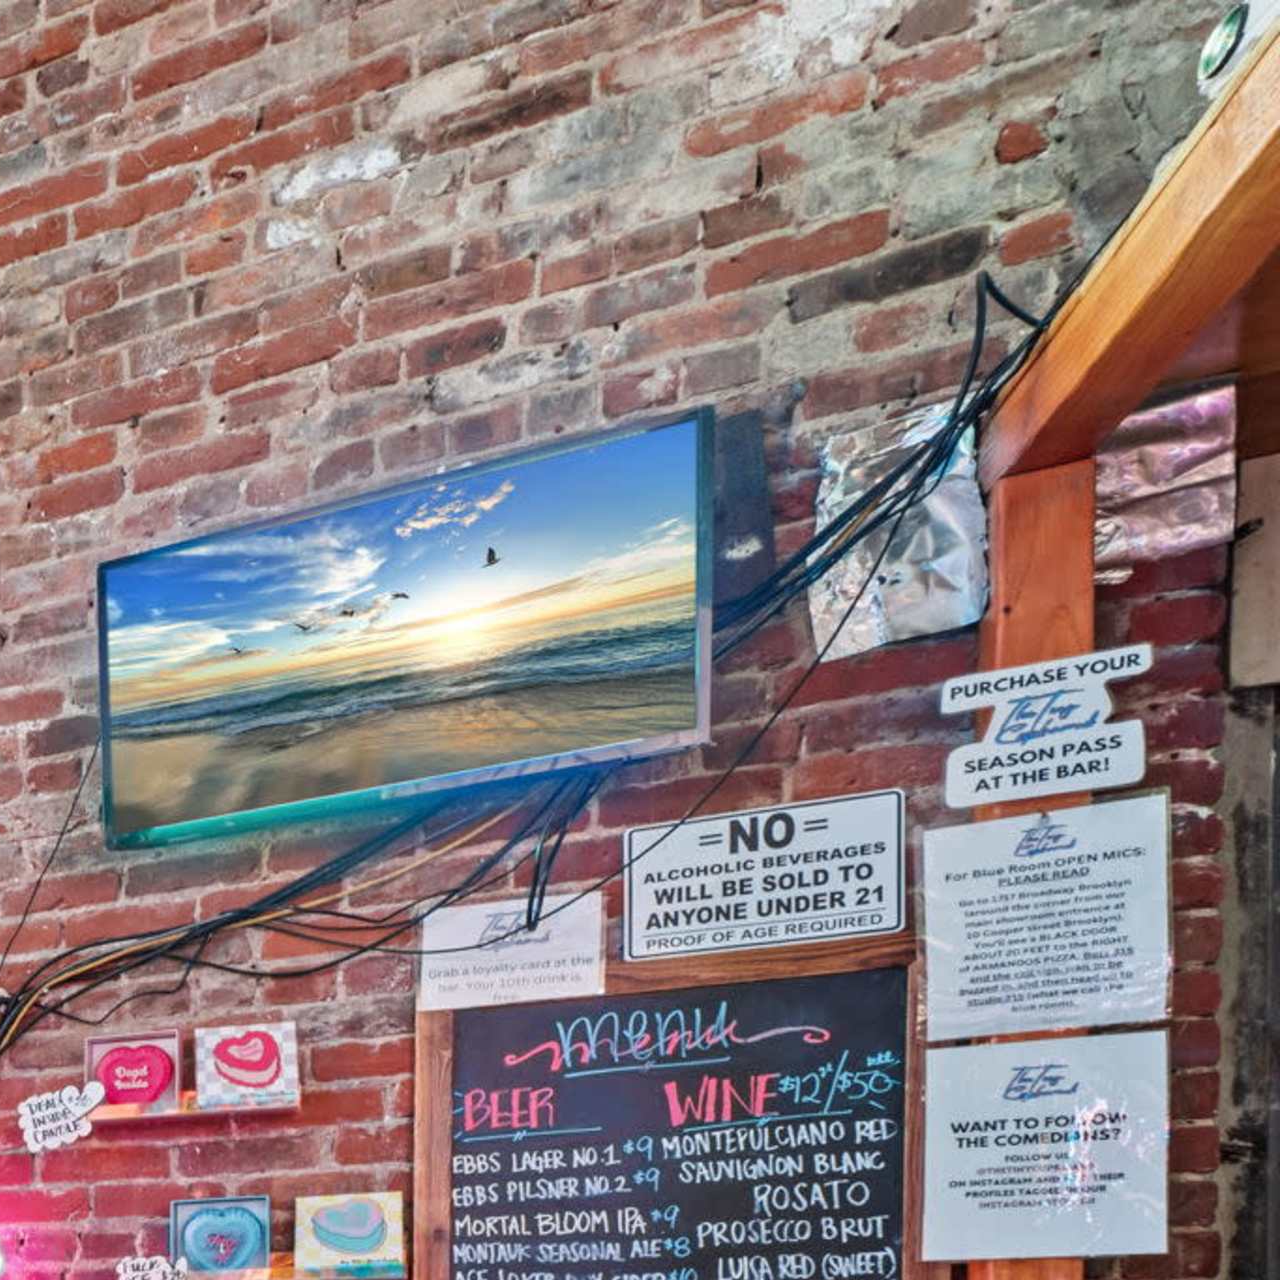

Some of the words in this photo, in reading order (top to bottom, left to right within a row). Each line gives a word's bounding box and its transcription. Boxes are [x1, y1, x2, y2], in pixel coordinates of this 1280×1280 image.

[950, 666, 1068, 700] PURCHASE
[1075, 653, 1141, 677] YOUR
[964, 748, 1055, 774] SEASON
[1062, 735, 1123, 757] PASS
[974, 776, 1003, 792] AT
[1009, 768, 1050, 786] THE
[1056, 758, 1110, 779] BAR!
[729, 812, 795, 855] NO
[644, 859, 755, 885] ALCOHOLIC
[762, 841, 887, 869] BEVERAGES
[945, 872, 969, 883] For
[972, 867, 1005, 878] Blue
[1009, 861, 1051, 873] Room
[1054, 854, 1098, 867] OPEN
[1102, 847, 1146, 861] MICS:
[998, 873, 1049, 887] PLEASE
[1052, 866, 1090, 881] READ
[654, 883, 713, 905] WILL
[722, 878, 753, 898] BE
[762, 868, 829, 892] SOLD
[838, 863, 873, 883] TO
[646, 903, 747, 930] ANYONE
[757, 891, 845, 917] UNDER
[855, 885, 884, 906] 21
[646, 932, 706, 950] PROOF
[712, 931, 736, 943] OF
[741, 921, 778, 940] AGE
[784, 913, 883, 935] REQUIRED
[473, 962, 519, 975] loyalty
[520, 958, 551, 969] card
[570, 953, 594, 965] the
[464, 1087, 554, 1132] BEER
[664, 1073, 780, 1127] WINE
[661, 1121, 845, 1160] MONTEPULCIANO
[855, 1118, 897, 1144] RED
[950, 1120, 1007, 1133] WANT
[1014, 1118, 1039, 1130] TO
[955, 1136, 988, 1149] THE
[453, 1152, 501, 1175] EBBS
[512, 1149, 567, 1173] LAGER
[623, 1135, 653, 1161] $9
[679, 1154, 805, 1184] SAUVIGNON
[814, 1151, 886, 1175] BLANC
[452, 1183, 499, 1207] EBBS
[507, 1179, 579, 1202] PILSNER
[633, 1168, 660, 1191] $9
[753, 1179, 870, 1217] ROSATO
[455, 1214, 531, 1237] MORTAL
[536, 1210, 609, 1235] BLOOM
[618, 1207, 647, 1235] IPA
[651, 1205, 680, 1229] $9
[696, 1219, 811, 1249] PROSECCO
[821, 1215, 889, 1243] BRUT
[453, 1242, 531, 1264] MONTAUK
[537, 1242, 626, 1263] SEASONAL
[630, 1239, 664, 1259] ALE
[664, 1237, 690, 1258] $8
[779, 1254, 815, 1280] RED
[822, 1246, 897, 1280] (SWEET)
